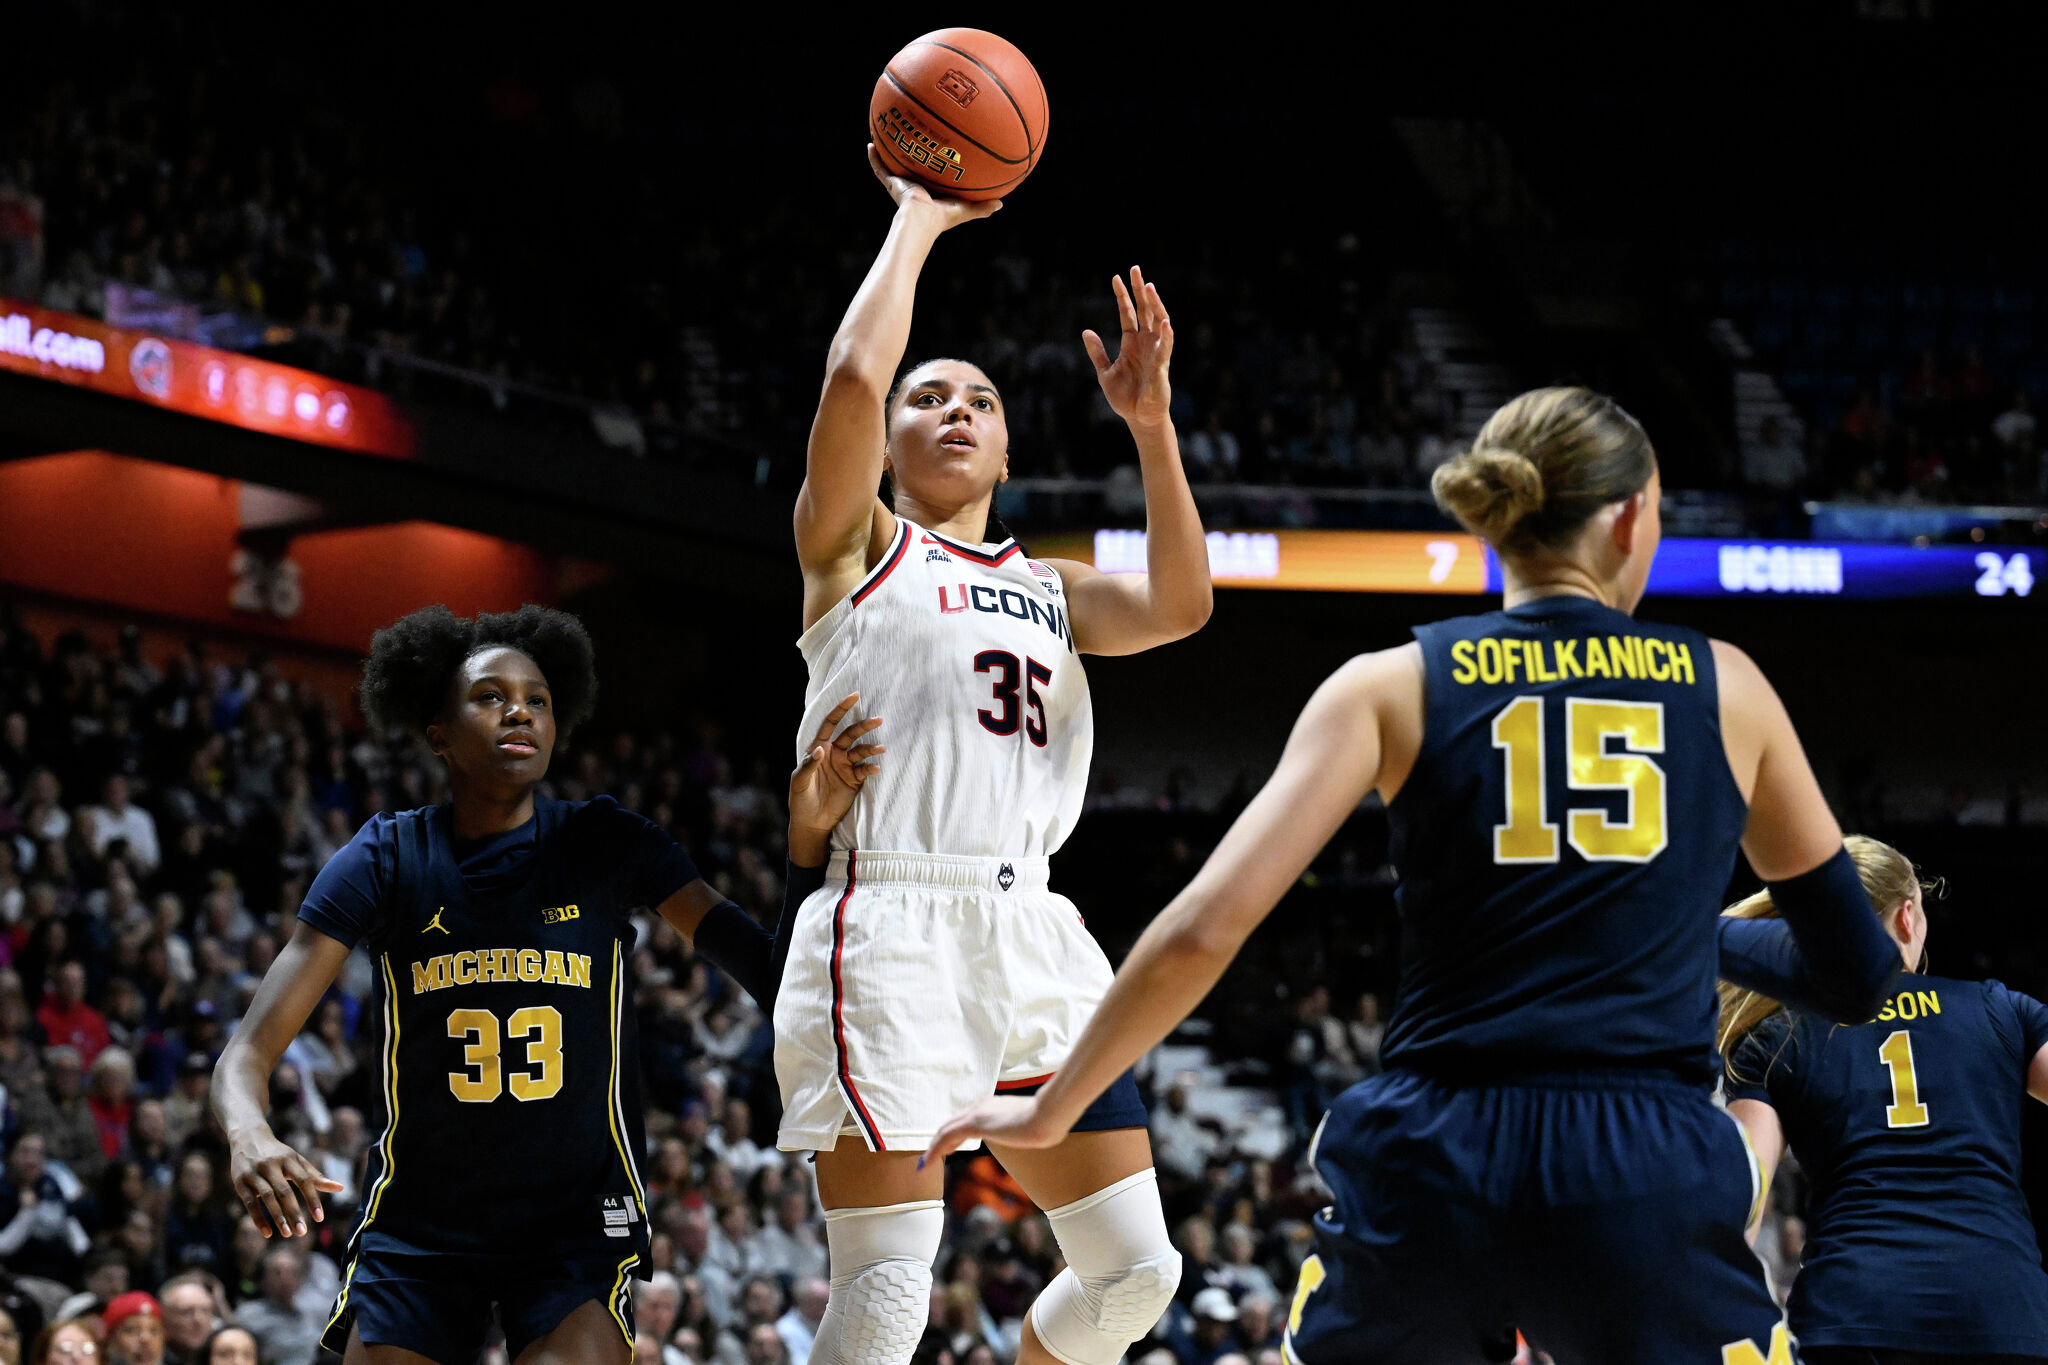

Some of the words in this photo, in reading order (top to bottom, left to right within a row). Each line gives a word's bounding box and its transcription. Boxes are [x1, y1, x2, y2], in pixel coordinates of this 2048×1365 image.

[878, 112, 965, 182] LEGACY
[926, 554, 952, 563] CHAN
[1426, 543, 1457, 583] 7
[1718, 545, 1843, 594] UCONN
[1974, 552, 2033, 597] 24
[938, 583, 1073, 654] UCONN
[1451, 635, 1696, 685] SOFILKANICH
[973, 649, 1052, 748] 35
[1491, 695, 1668, 864] 15
[412, 948, 592, 995] MICHIGAN
[447, 1005, 563, 1103] 33
[1878, 1029, 1930, 1129] 1
[603, 1198, 618, 1208] 44
